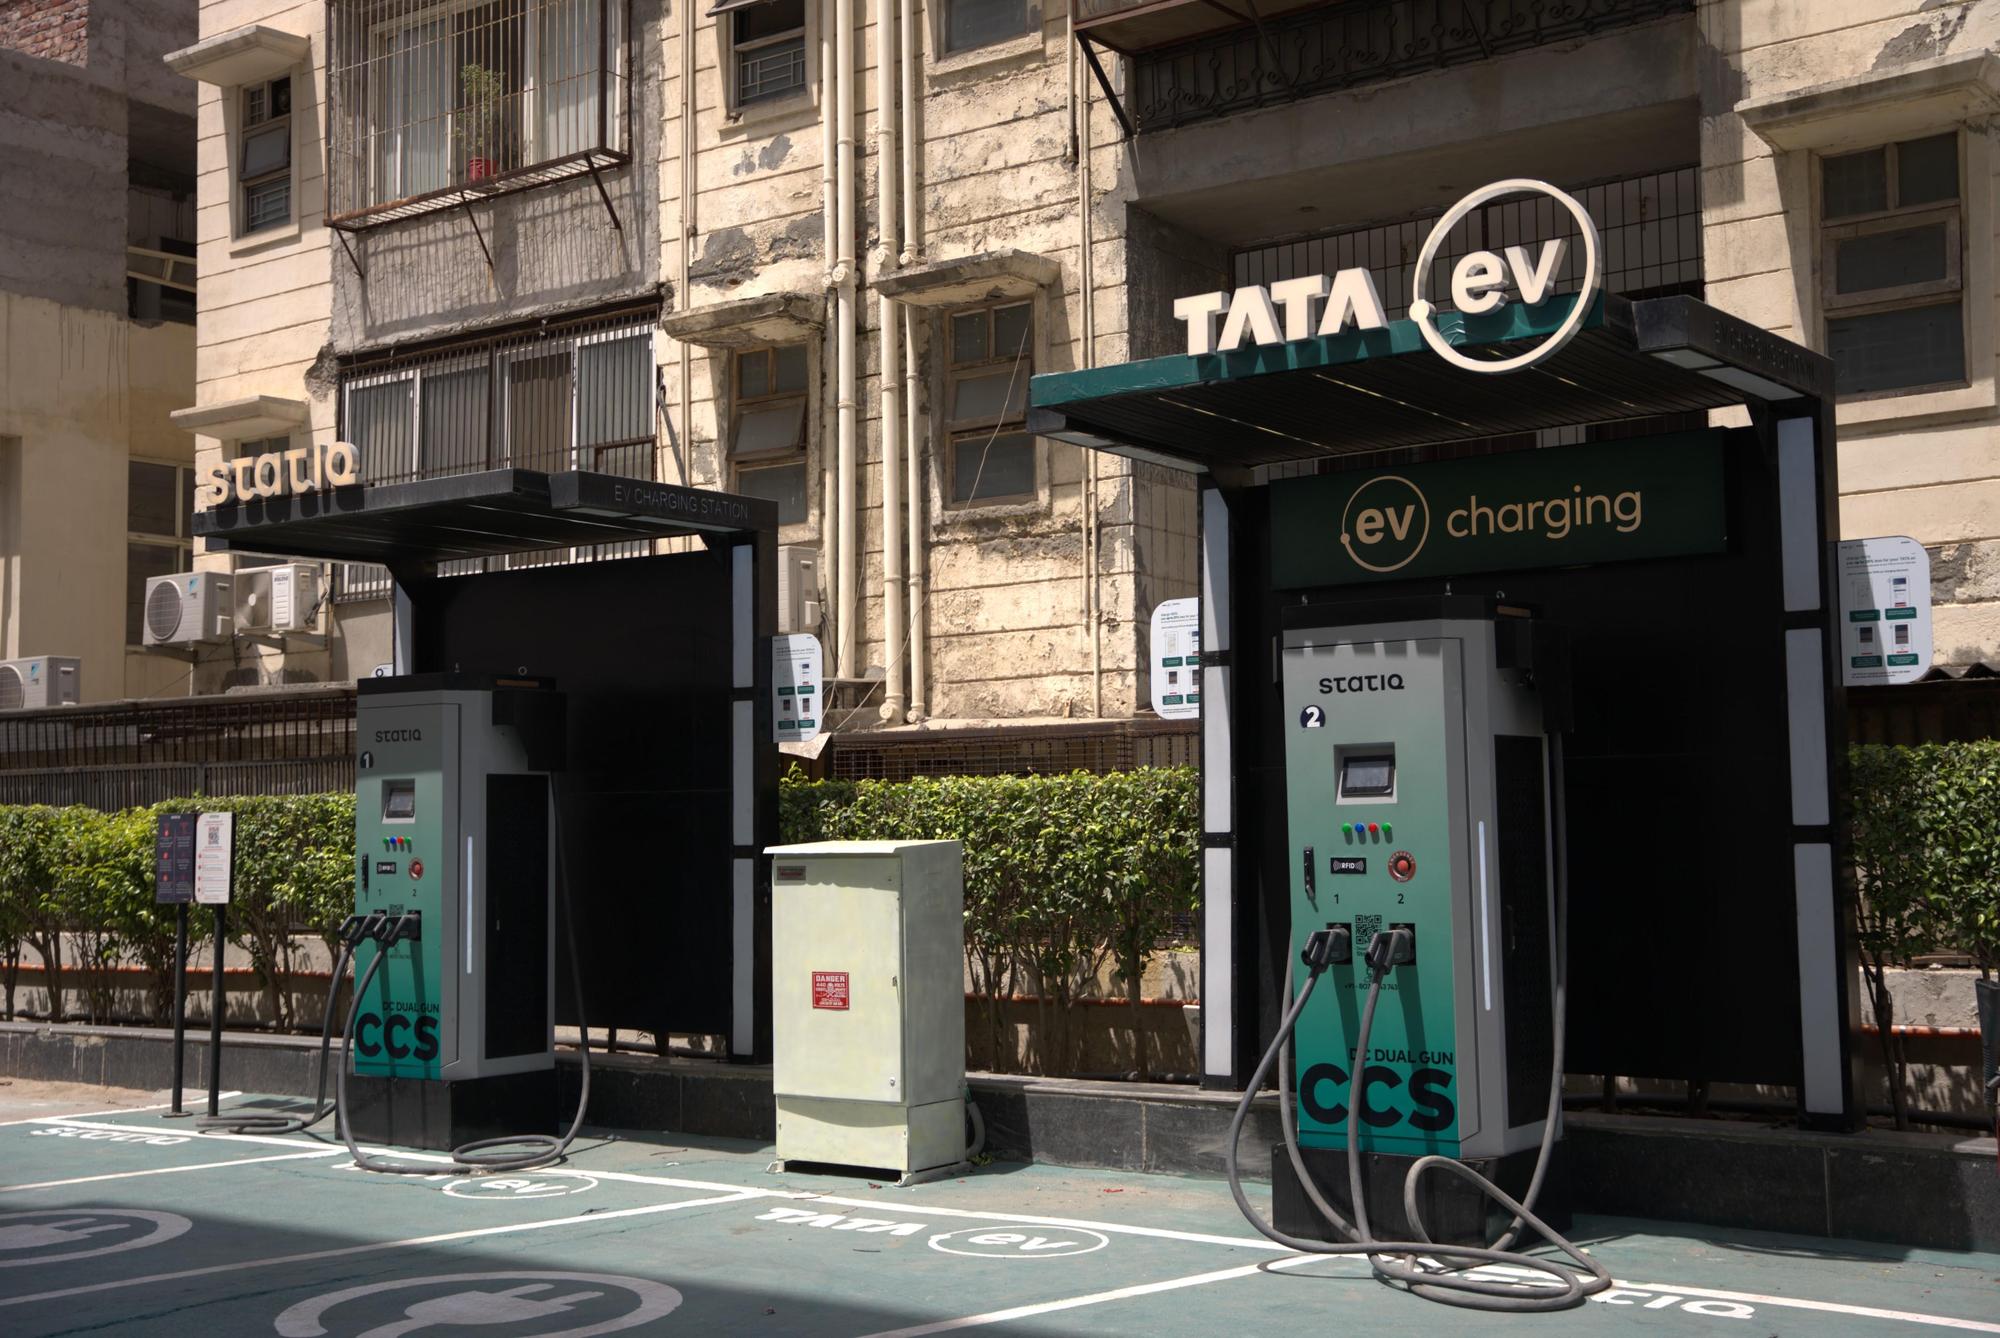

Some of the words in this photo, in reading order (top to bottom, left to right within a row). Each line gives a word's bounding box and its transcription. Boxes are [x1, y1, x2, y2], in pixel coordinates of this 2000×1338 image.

[1173, 267, 1390, 357] TATA
[614, 484, 632, 502] EV
[633, 487, 698, 513] CHARGING
[701, 497, 750, 520] STATION
[1446, 484, 1642, 540] charging
[1304, 705, 1321, 728] 2
[1333, 893, 1339, 905] 1
[1397, 893, 1405, 905] 2
[382, 1002, 394, 1011] DC
[396, 1002, 419, 1012] DUAL
[420, 1002, 440, 1013] GUN
[355, 1012, 439, 1062] CCS
[1374, 1049, 1417, 1064] DUAL
[1418, 1050, 1454, 1065] GUN
[1299, 1063, 1455, 1132] CCS
[754, 1206, 929, 1236] TATA
